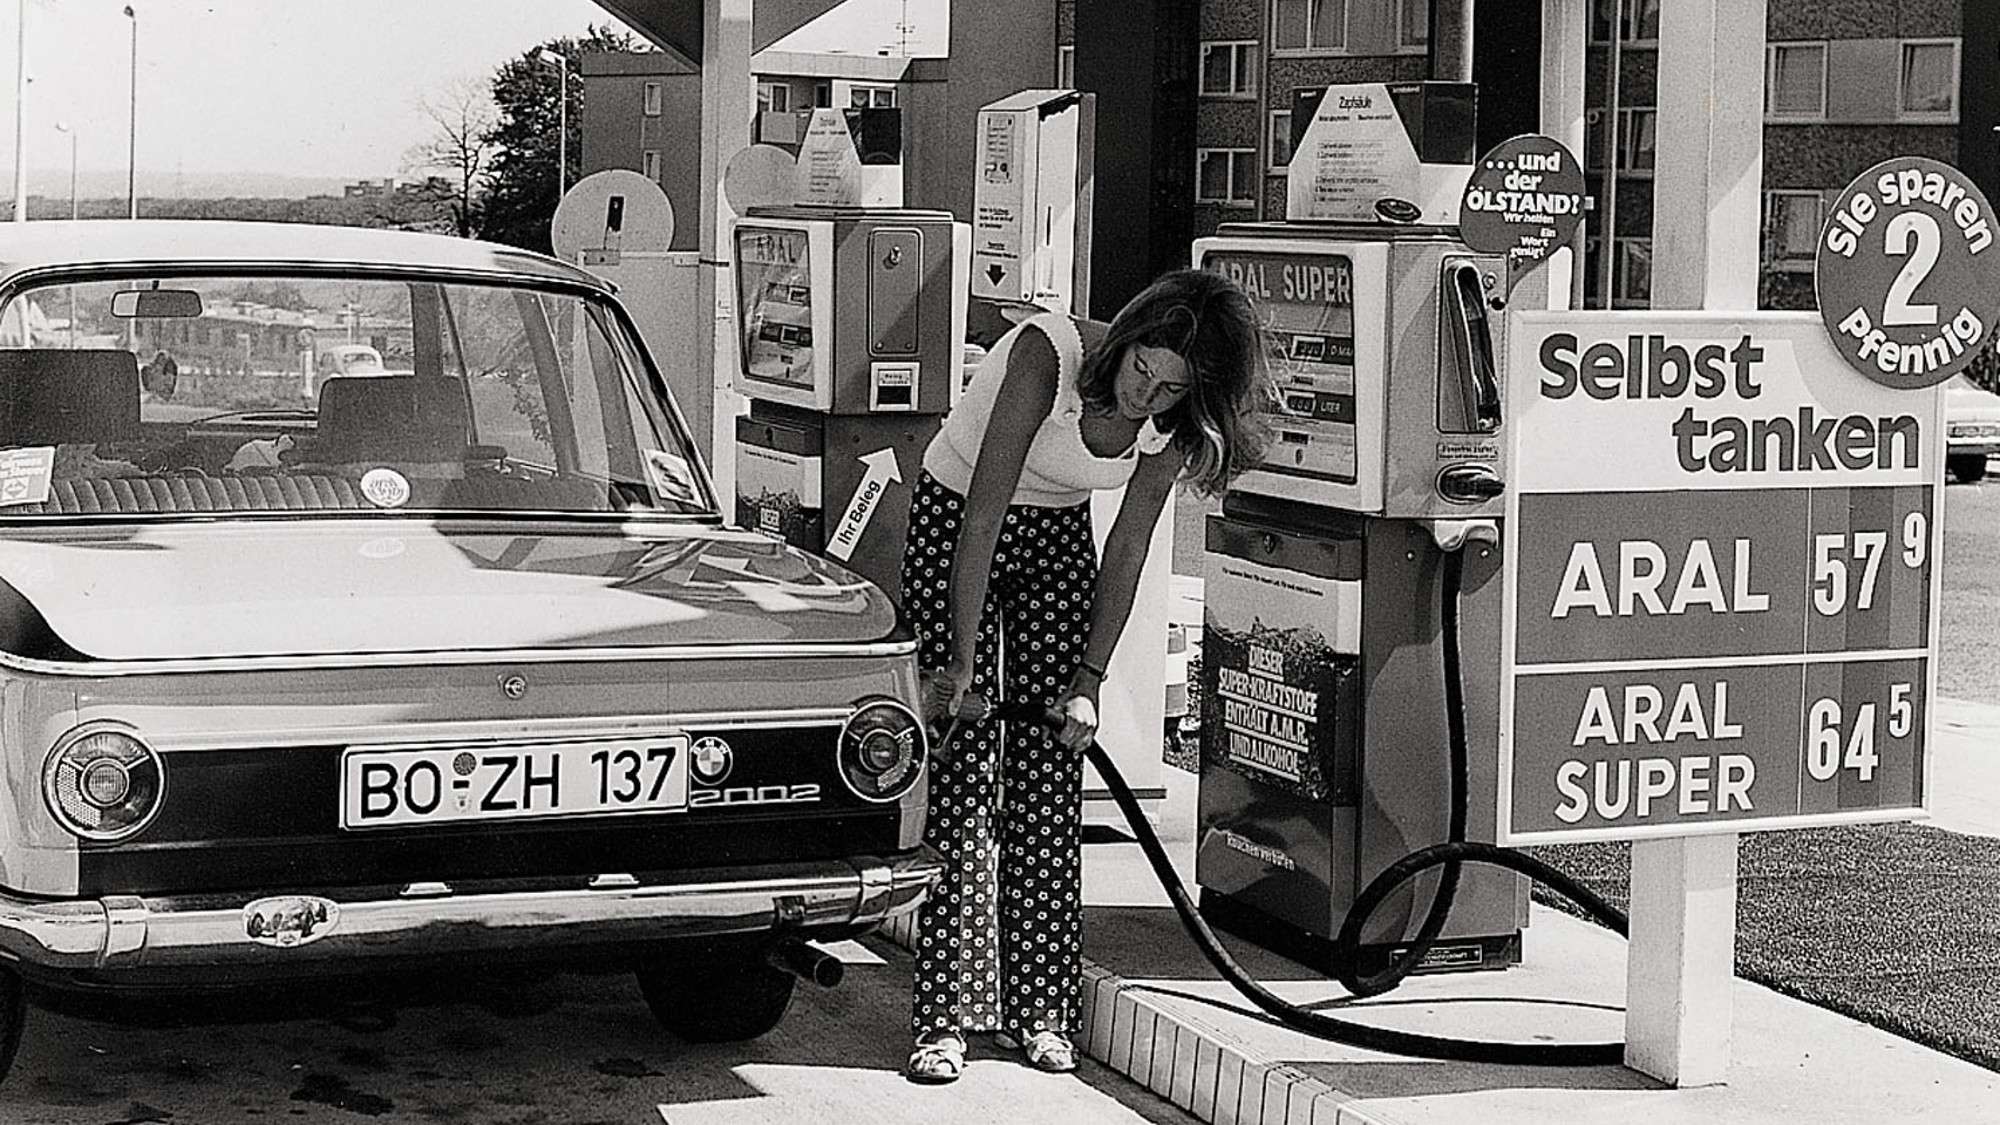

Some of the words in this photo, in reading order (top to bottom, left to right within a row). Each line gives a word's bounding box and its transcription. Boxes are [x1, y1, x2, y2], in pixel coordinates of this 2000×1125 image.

[1504, 169, 1543, 191] der
[1503, 211, 1523, 223] Wir
[1523, 213, 1555, 224] helfen
[1520, 236, 1549, 247] Wort
[1827, 193, 1877, 257] Sie
[1877, 168, 1993, 255] sparen
[1283, 264, 1351, 303] SUPER
[1882, 211, 1941, 326] 2
[1539, 333, 1764, 400] Selbst
[1838, 306, 1983, 374] Pfennig
[1672, 406, 1920, 473] tanken
[837, 522, 857, 545] Ihr
[849, 480, 881, 523] Beleg
[1551, 538, 1770, 618] ARAL
[1249, 645, 1283, 677] DIESER
[1573, 681, 1744, 746] ARAL
[592, 747, 676, 804] 137
[693, 738, 729, 755] BMW
[1230, 732, 1250, 757] UND
[1250, 739, 1300, 774] ALKOHOL
[690, 784, 821, 807] 2002
[1554, 753, 1756, 824] SUPER
